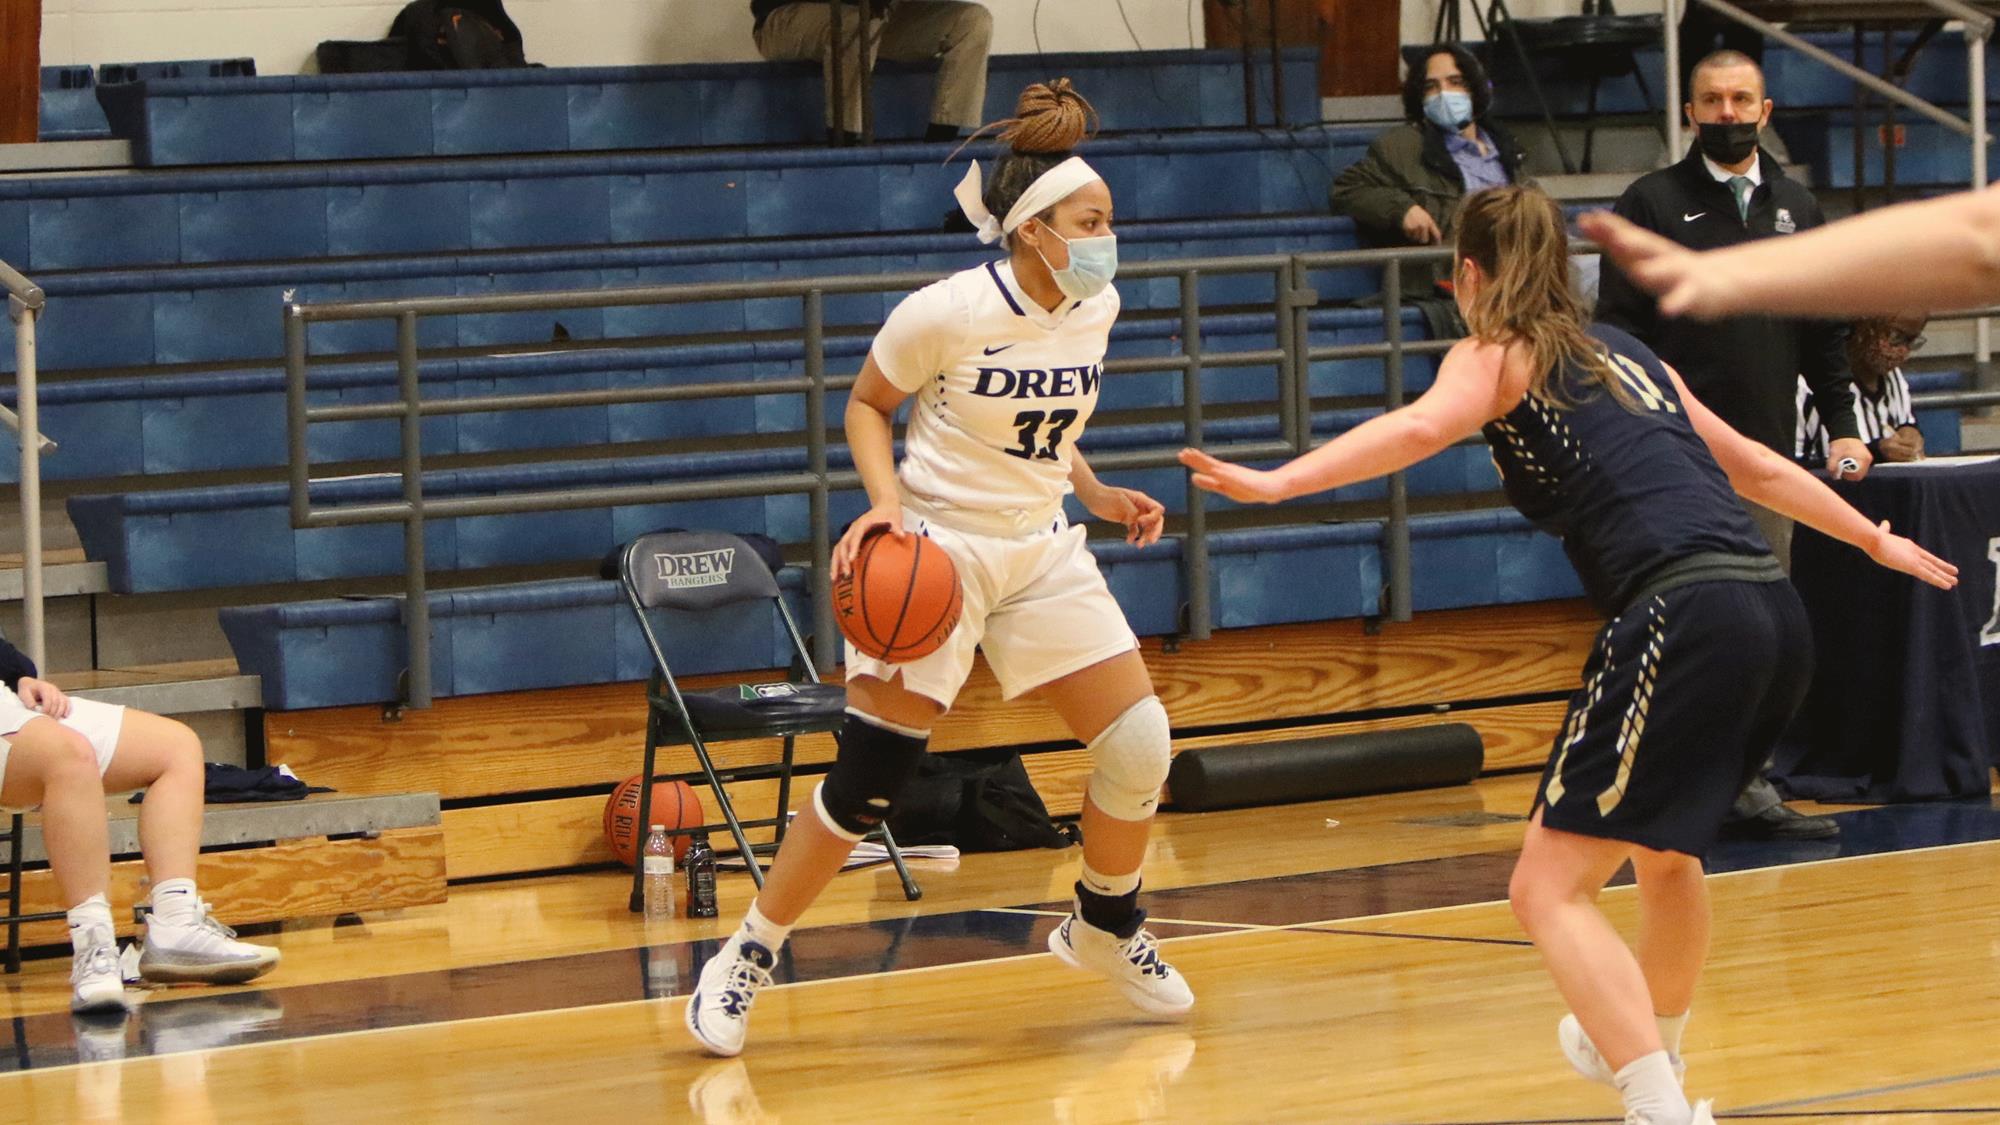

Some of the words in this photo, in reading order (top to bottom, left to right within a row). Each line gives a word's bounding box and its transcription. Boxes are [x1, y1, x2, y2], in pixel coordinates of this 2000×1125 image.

[968, 364, 1100, 399] DREW
[1004, 409, 1078, 461] 33
[656, 549, 734, 578] DREW
[669, 573, 725, 588] RANGERS
